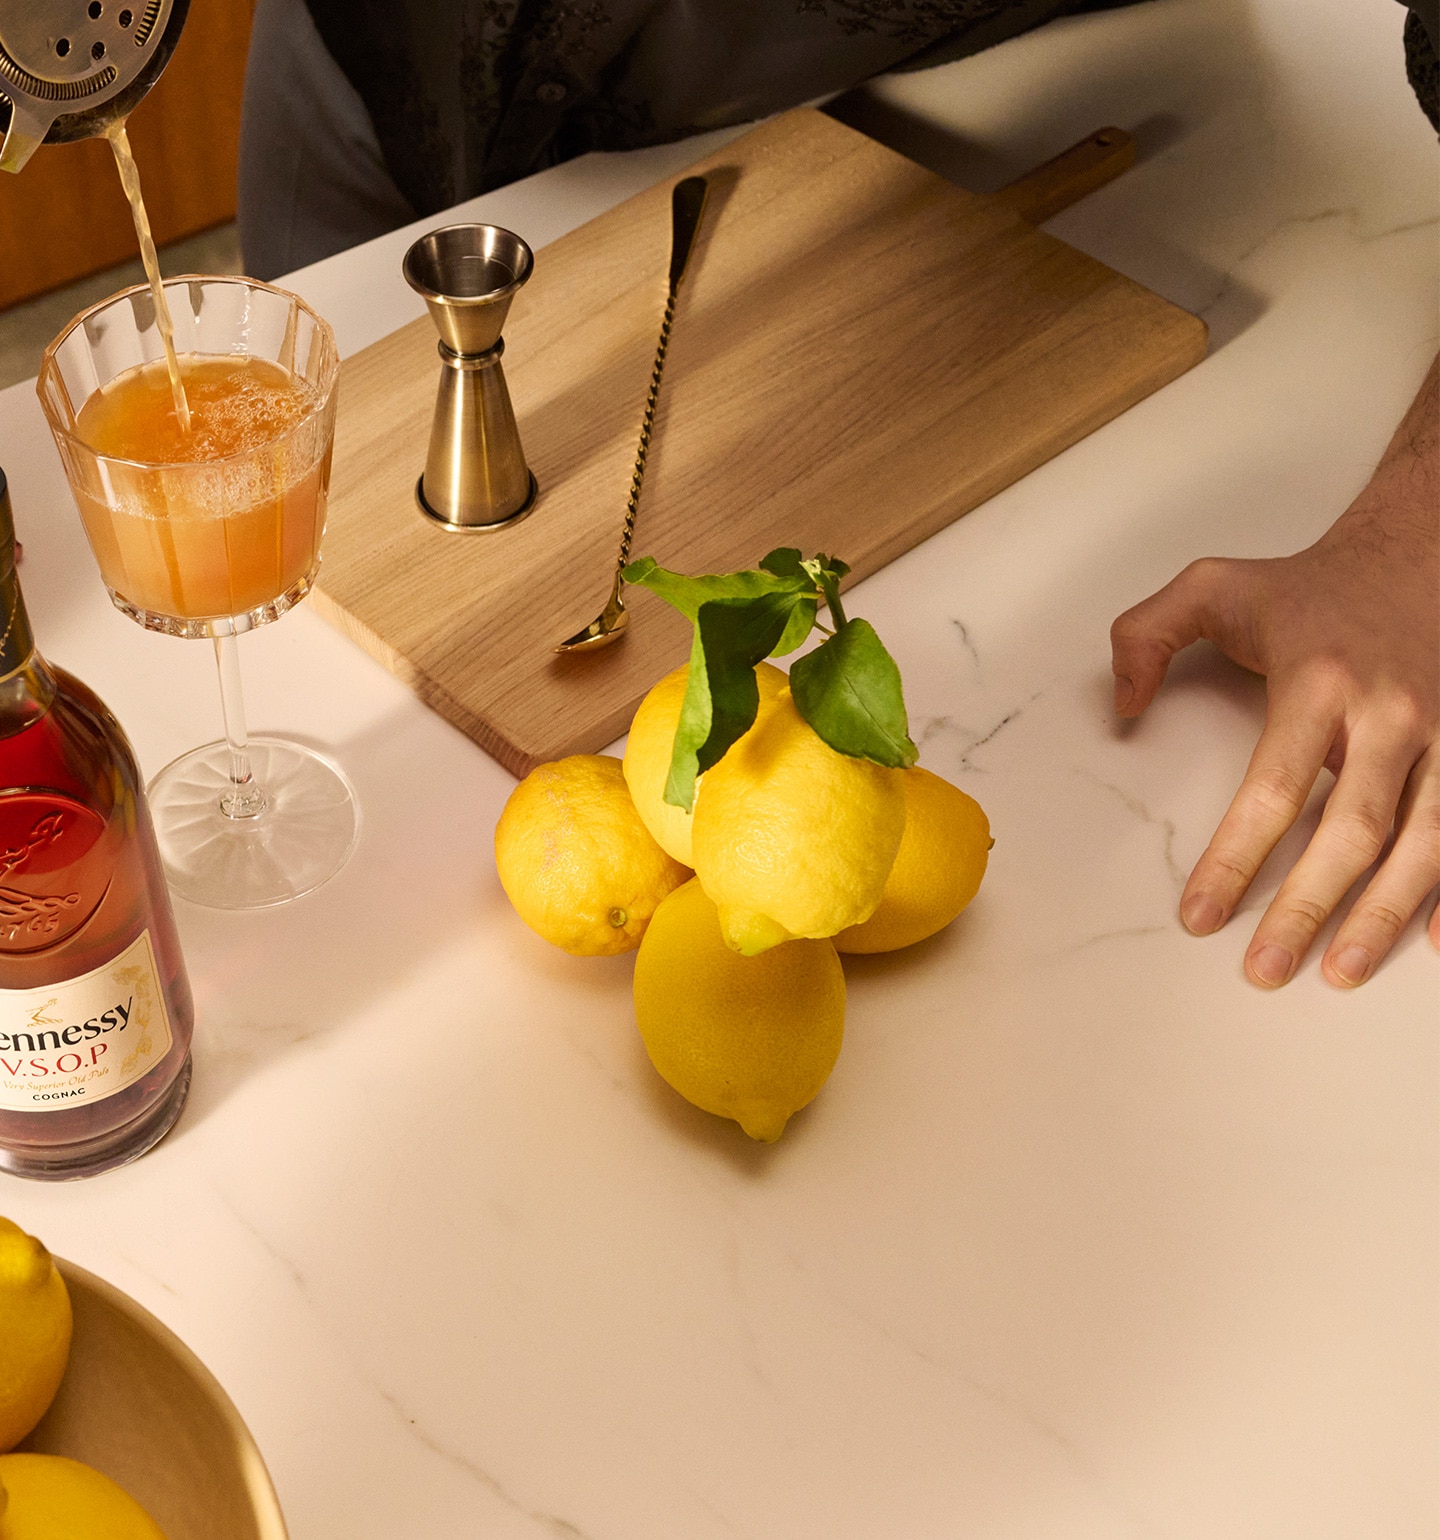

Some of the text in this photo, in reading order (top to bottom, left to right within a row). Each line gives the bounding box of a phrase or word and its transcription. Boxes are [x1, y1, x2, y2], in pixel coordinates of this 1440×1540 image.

[0, 1043, 108, 1078] V.S.O.P
[3, 1066, 110, 1092] Very Superior Old Pale
[32, 1088, 86, 1101] COGNAC
